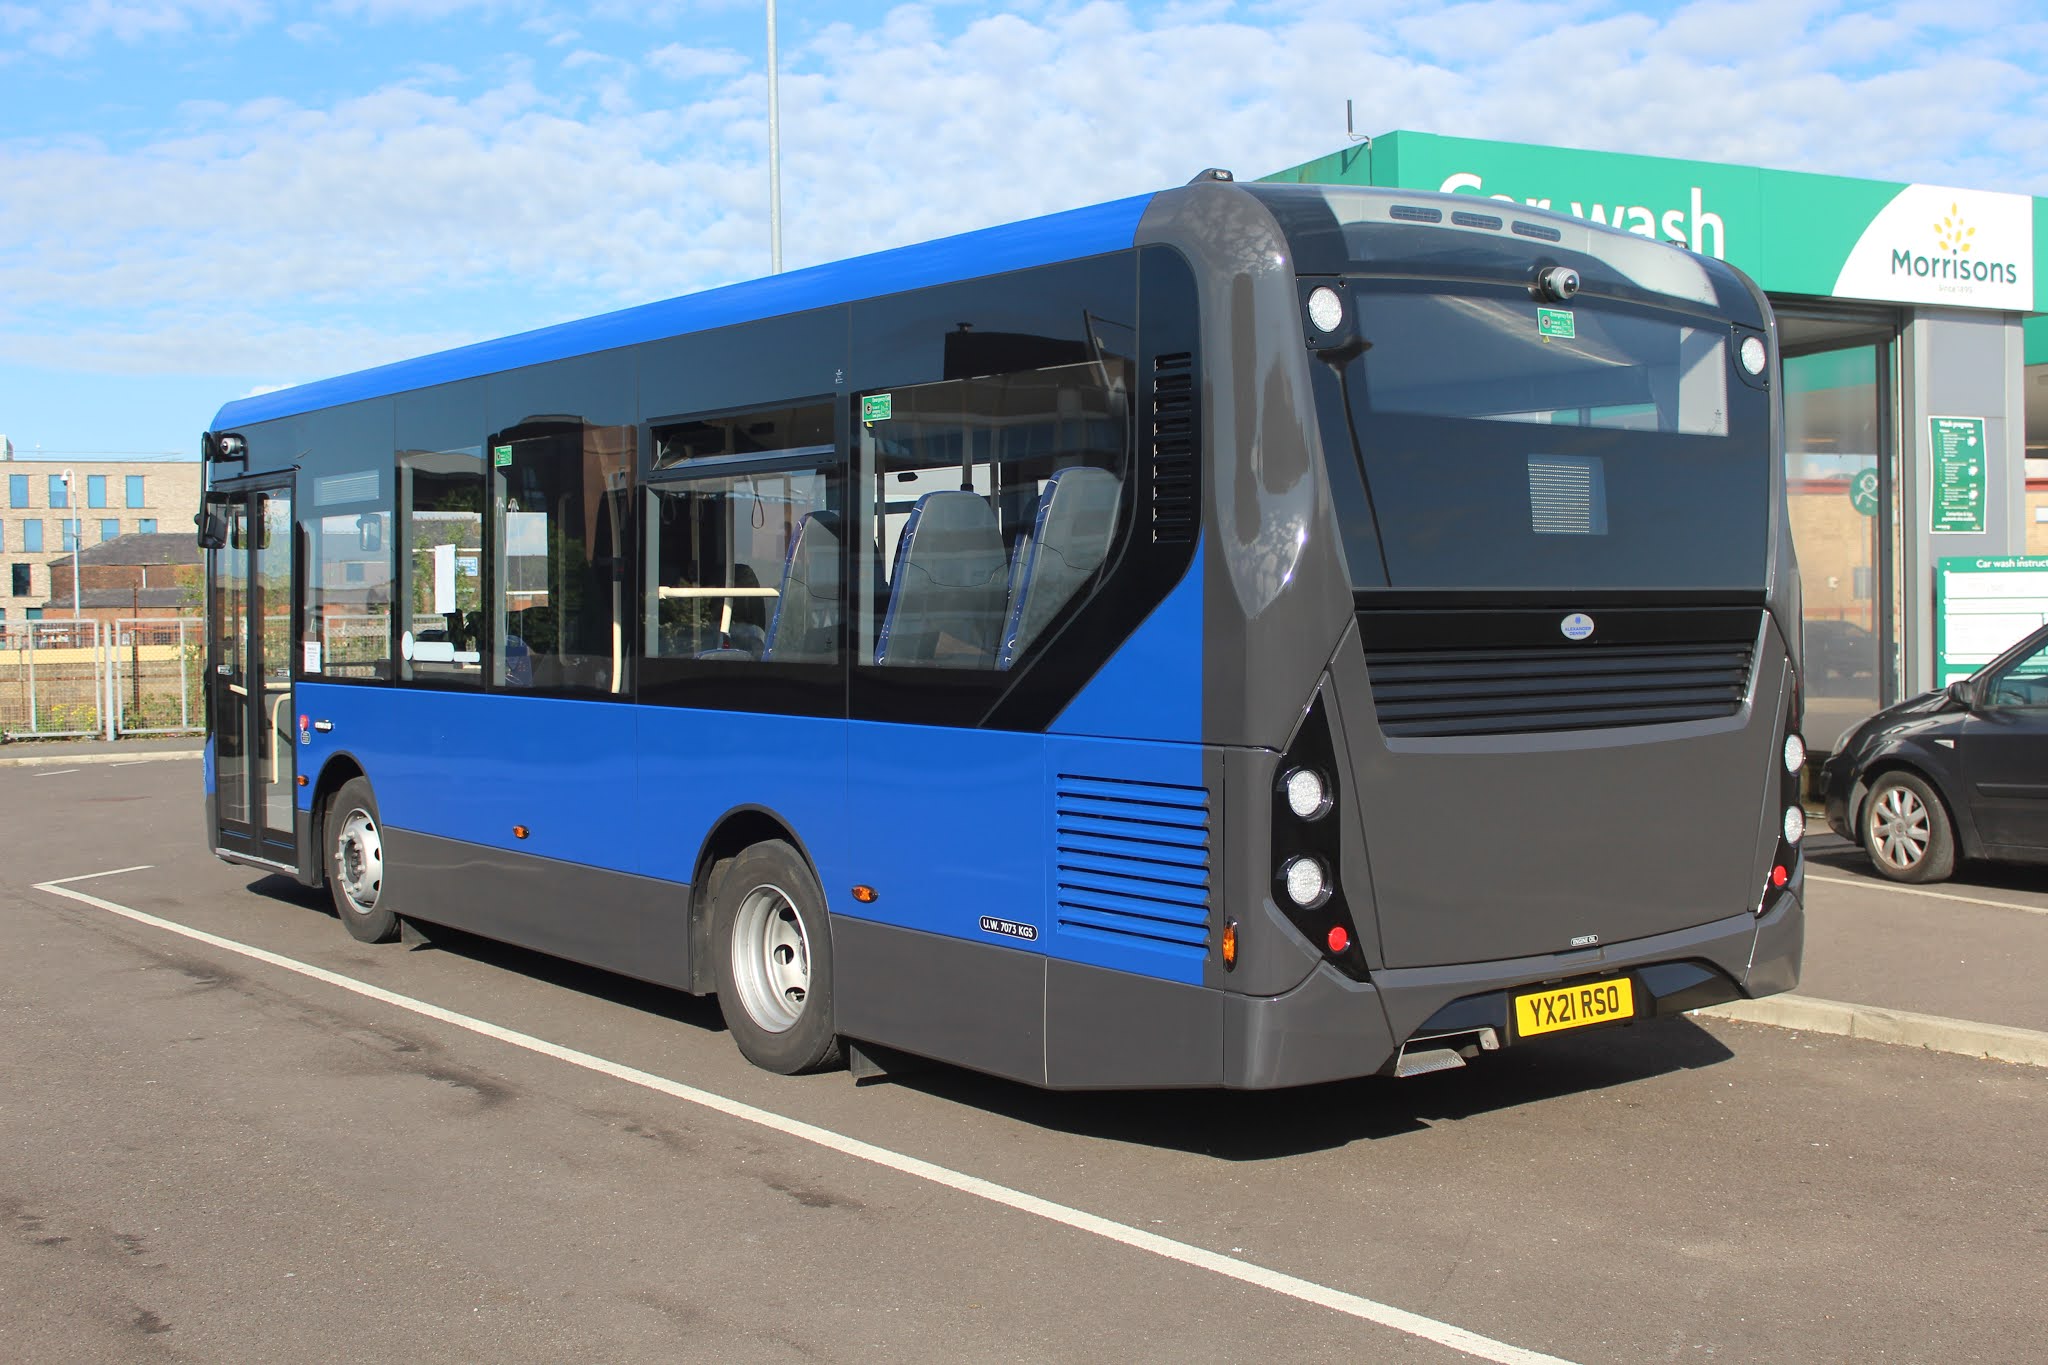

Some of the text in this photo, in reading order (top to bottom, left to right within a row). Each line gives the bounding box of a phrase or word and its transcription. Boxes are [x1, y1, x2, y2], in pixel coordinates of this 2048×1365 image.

[1892, 248, 2017, 284] Morrisons
[1976, 559, 1992, 568] Car
[1993, 558, 2015, 568] wash
[983, 918, 1034, 938] U.W. 7073 KGS
[1530, 985, 1620, 1027] YX21 RSO
